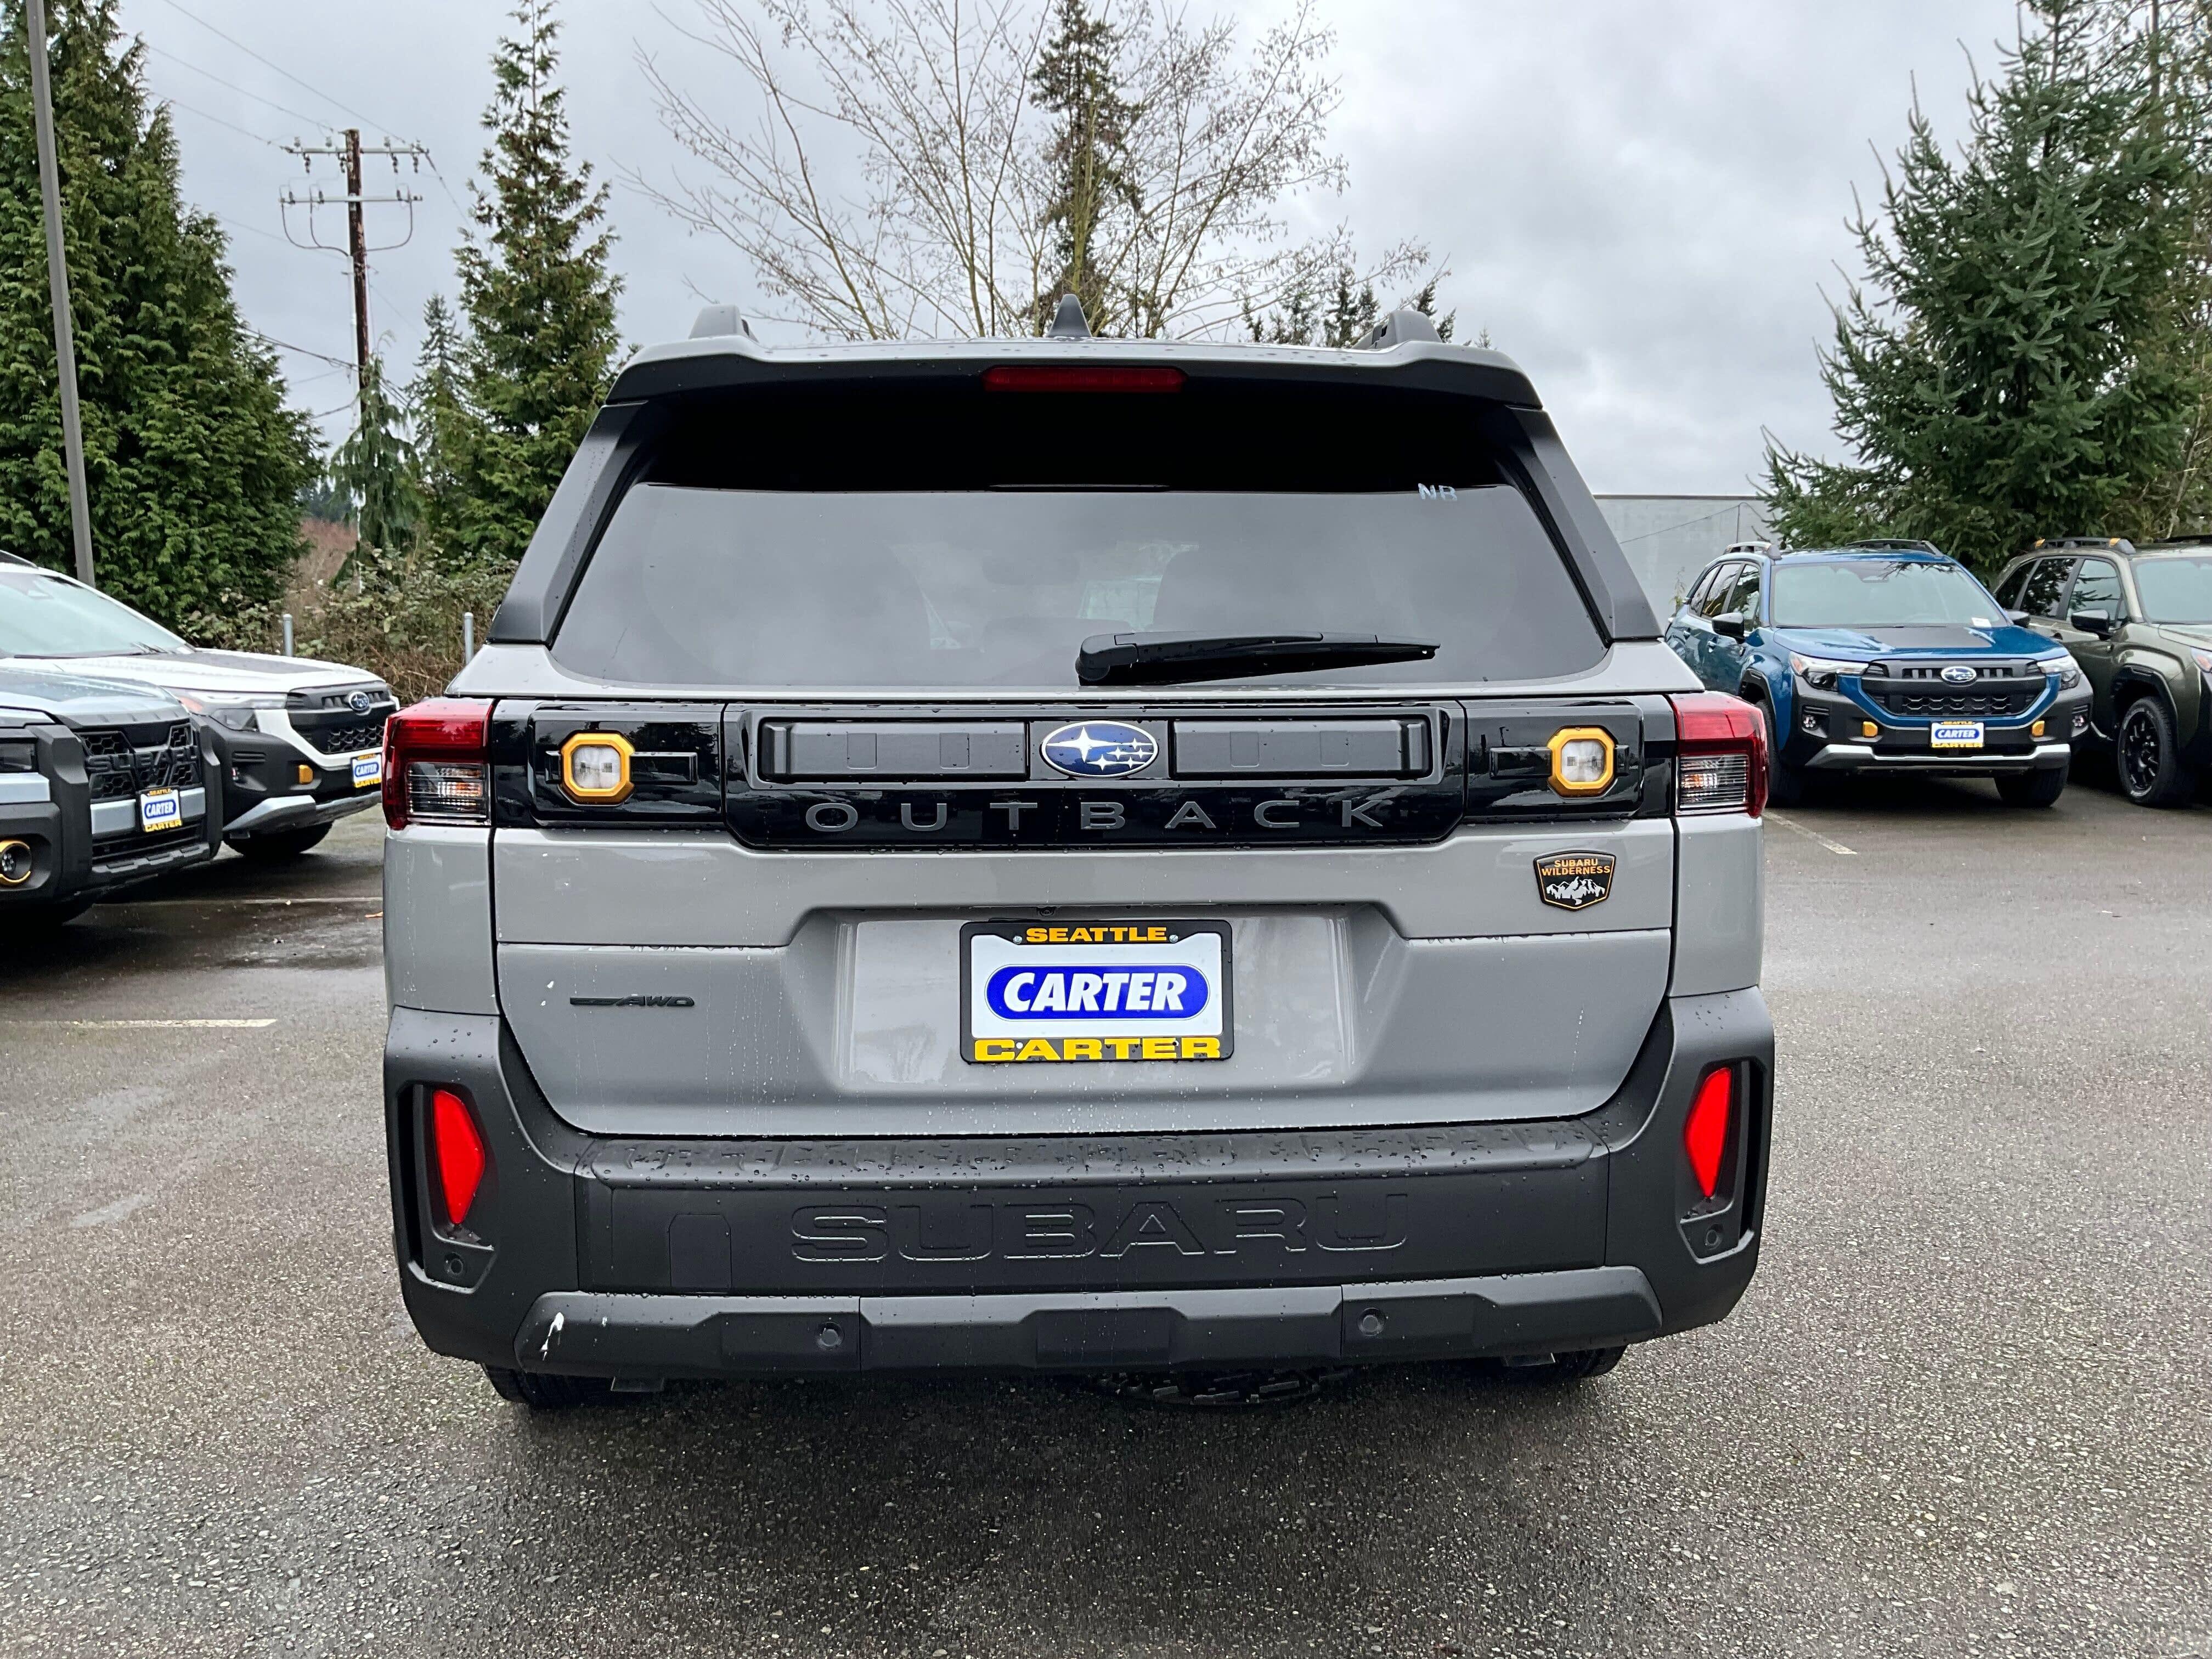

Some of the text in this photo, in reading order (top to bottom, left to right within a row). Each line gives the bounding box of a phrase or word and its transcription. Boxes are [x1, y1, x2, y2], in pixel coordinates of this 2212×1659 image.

[1938, 729, 1976, 738] CARTER
[356, 763, 377, 776] CARTER
[146, 801, 174, 817] CARTER
[805, 798, 1384, 833] OUTBACK
[145, 819, 182, 832] CARTER
[1554, 858, 1598, 867] SUBARU
[1541, 865, 1611, 876] WILDERNESS
[1025, 927, 1167, 943] SEATTLE
[1003, 972, 1187, 1012] CARTER
[616, 996, 695, 1007] AWD
[974, 1037, 1221, 1061] CARTER
[791, 1194, 1408, 1262] SUBARU
